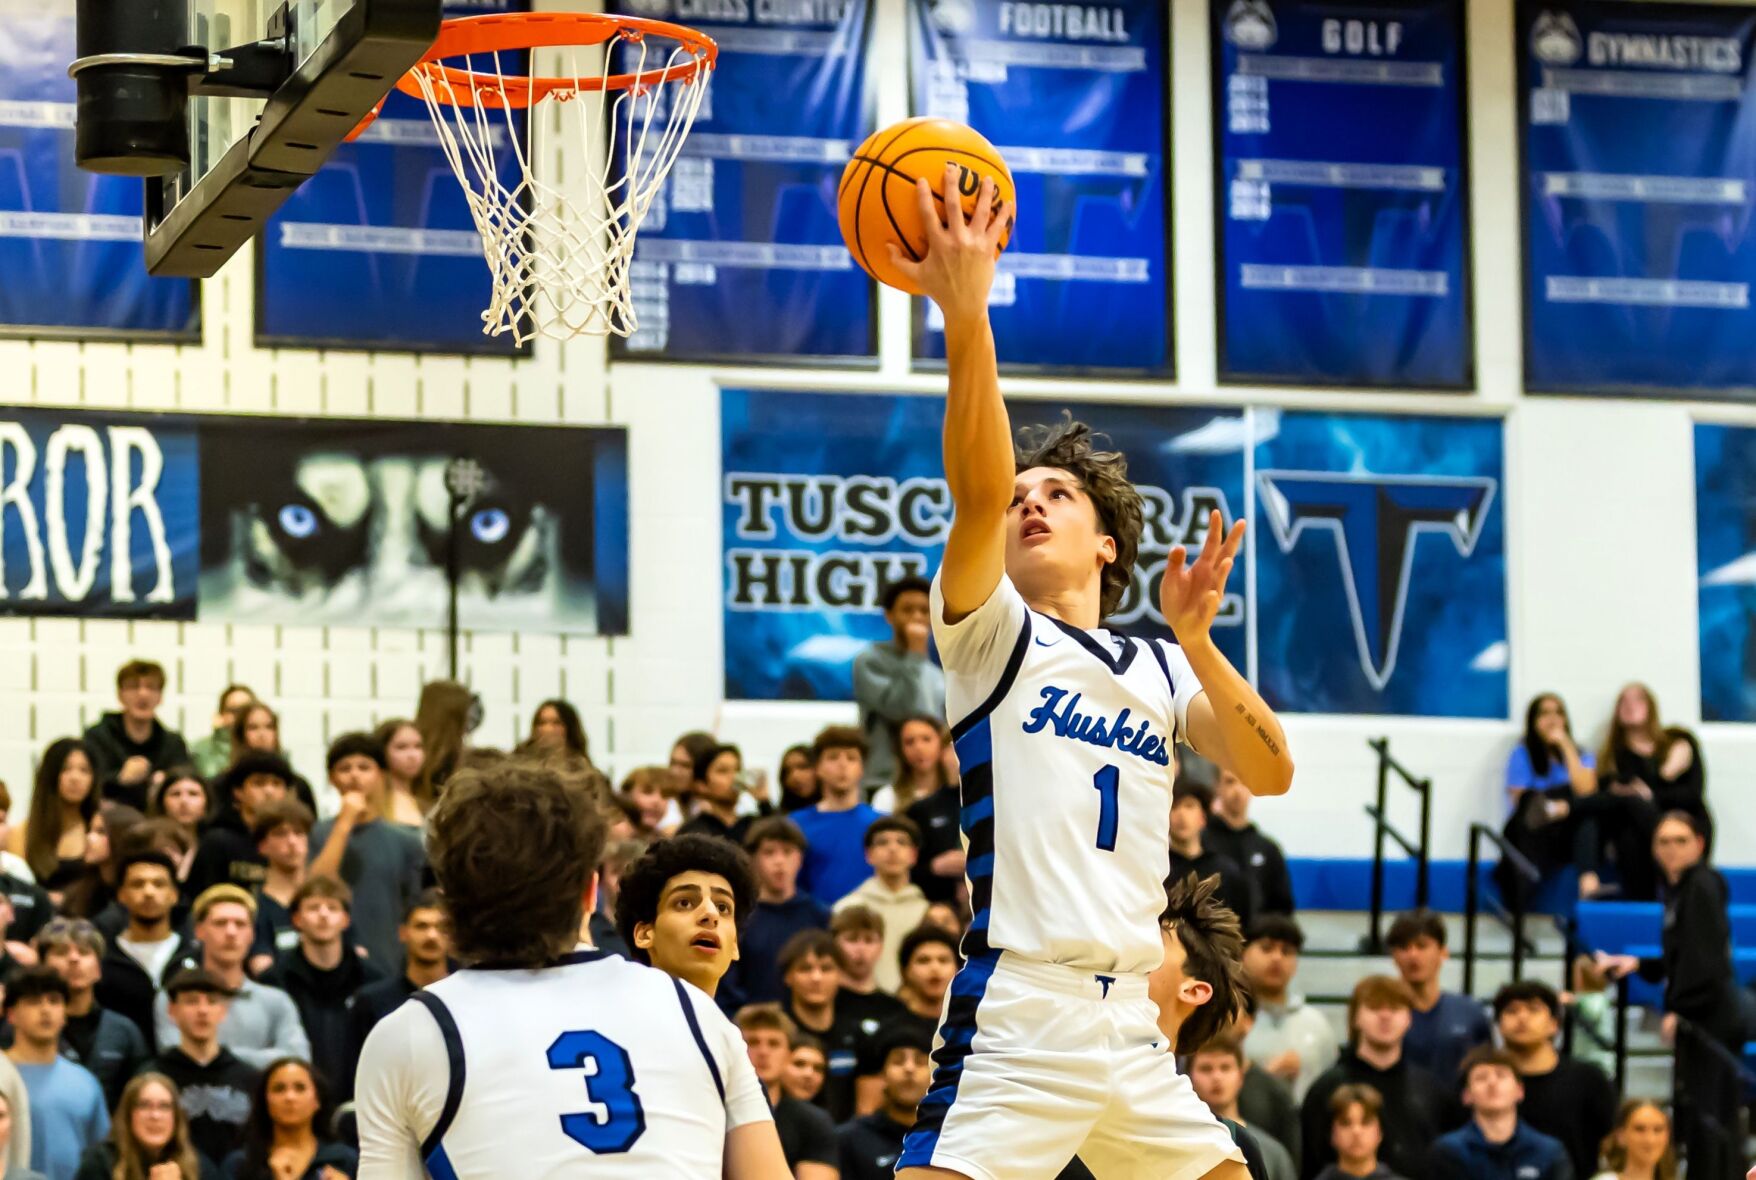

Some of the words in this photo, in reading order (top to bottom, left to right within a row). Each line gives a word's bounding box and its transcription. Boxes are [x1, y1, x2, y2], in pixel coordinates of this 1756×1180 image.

[1000, 2, 1131, 42] FOOTBALL
[1321, 18, 1402, 56] GOLF
[1588, 31, 1742, 73] GYMNASTICS
[1022, 685, 1169, 766] Huskies
[1093, 764, 1120, 852] 1
[545, 1029, 647, 1155] 3
